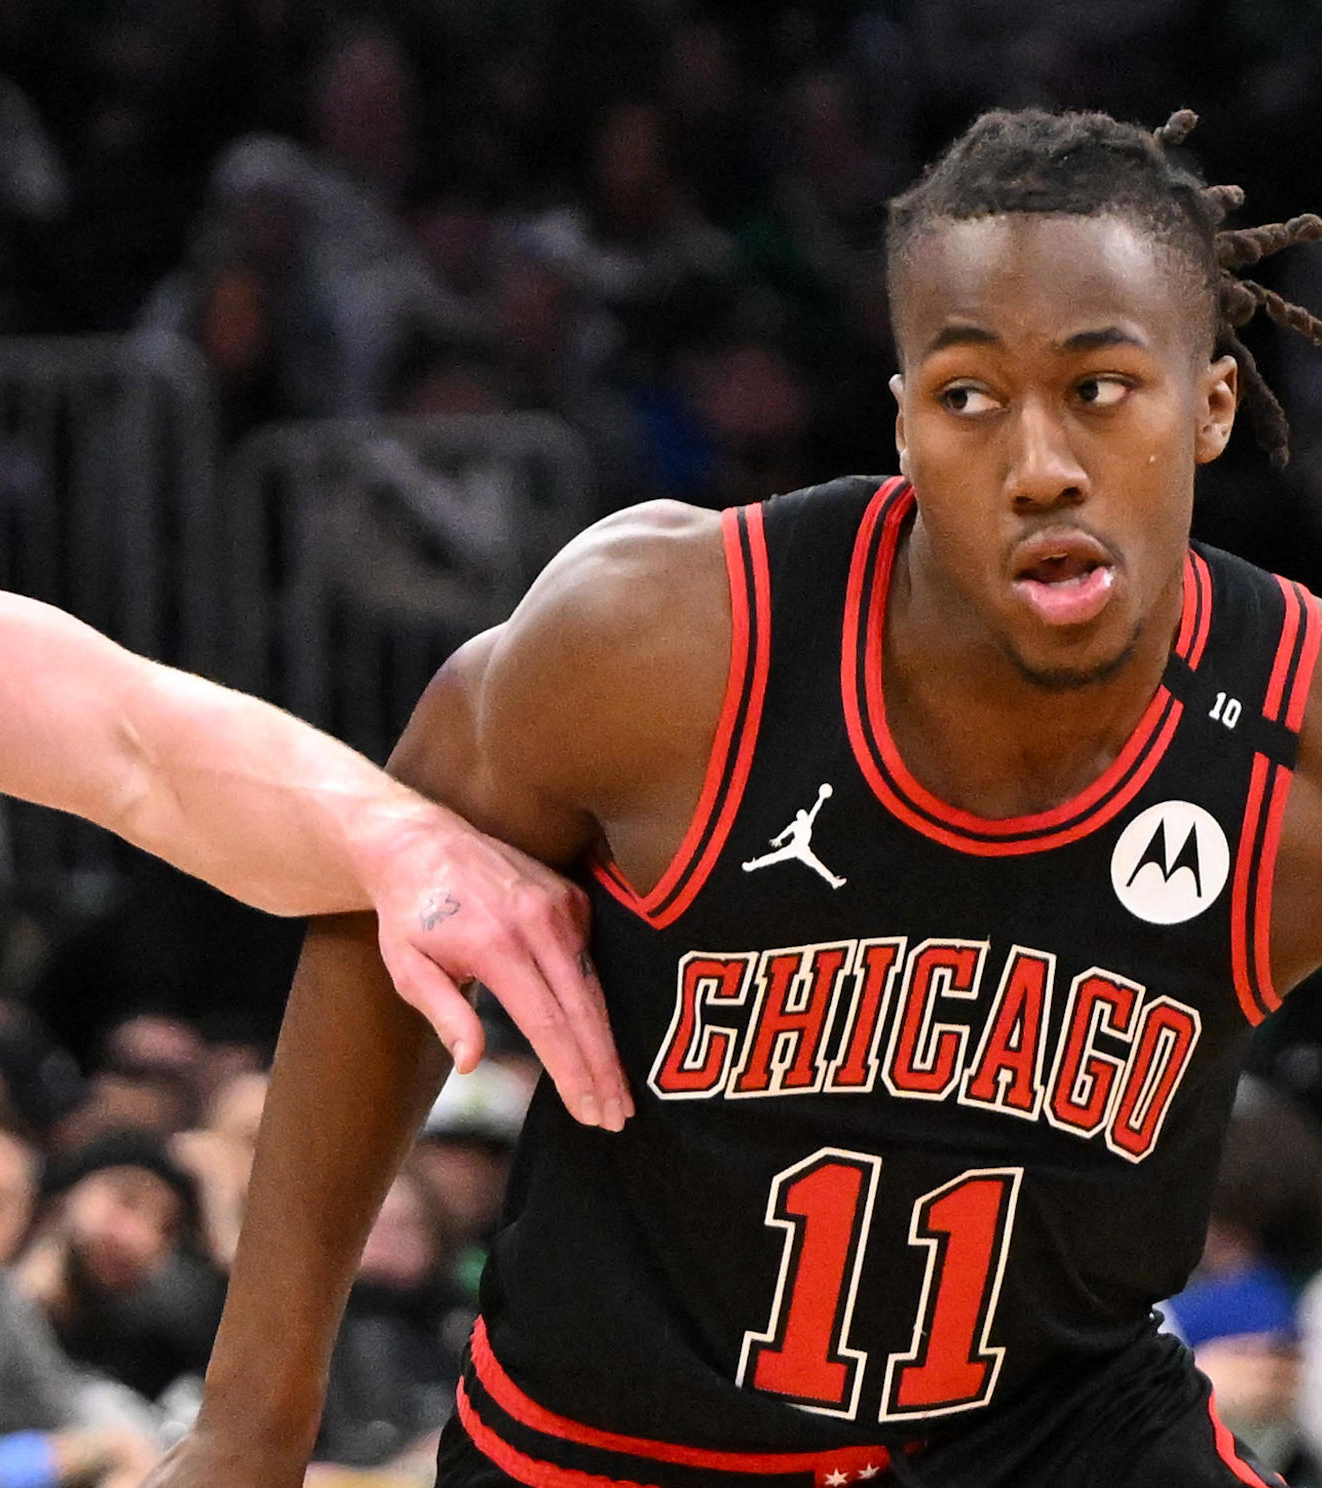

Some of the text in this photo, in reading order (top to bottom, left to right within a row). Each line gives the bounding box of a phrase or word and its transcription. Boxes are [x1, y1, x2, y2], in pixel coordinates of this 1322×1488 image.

[1208, 691, 1242, 730] 10
[647, 936, 1202, 1164] CHICAGO
[736, 1146, 1023, 1423] 11
